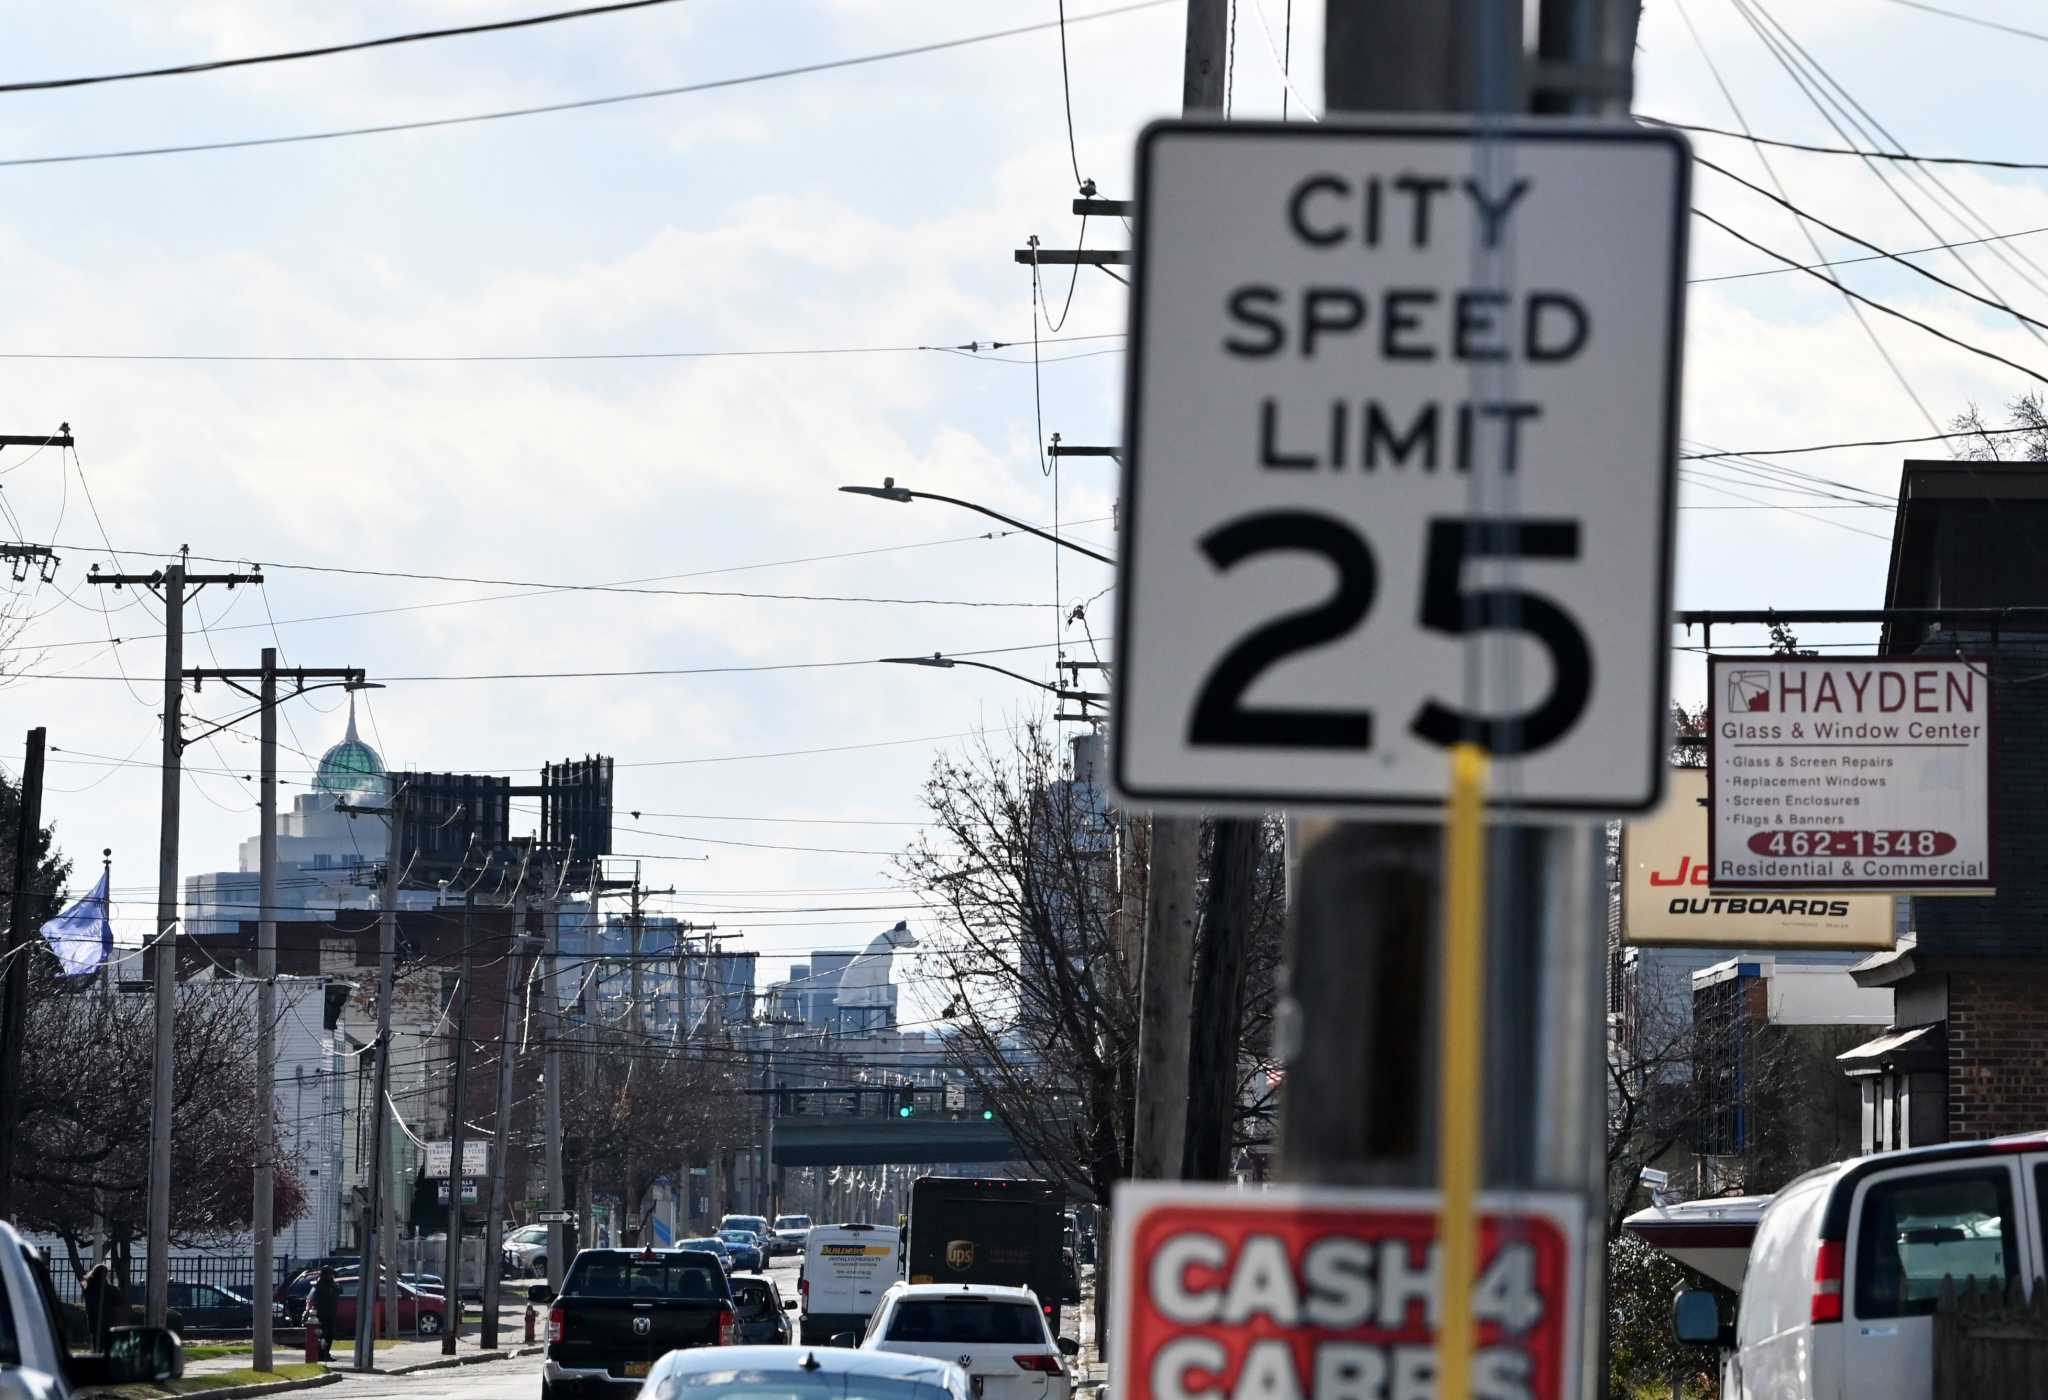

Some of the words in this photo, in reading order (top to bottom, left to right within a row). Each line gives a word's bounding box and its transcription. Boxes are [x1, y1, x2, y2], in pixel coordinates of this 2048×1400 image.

[1288, 173, 1533, 251] CITY
[1223, 284, 1590, 364] SPEED
[1260, 400, 1541, 473] LIMIT
[1187, 506, 1595, 758] 25
[1780, 670, 1973, 713] HAYDEN
[1721, 722, 1782, 739] Glass
[1791, 722, 1804, 739] &
[1814, 721, 1899, 739] Window
[1908, 721, 1980, 739] Center
[1733, 756, 1771, 768] Glass
[1776, 756, 1784, 767] &
[1790, 756, 1837, 767] Screen
[1842, 756, 1894, 770] Repairs
[1733, 776, 1821, 789] Replacement
[1826, 775, 1887, 787] Windows
[1733, 795, 1780, 806] Screen
[1785, 795, 1860, 806] Enclosures
[1733, 814, 1769, 827] Flags
[1775, 814, 1784, 825] &
[1789, 814, 1845, 825] Banners
[1768, 831, 1936, 856] 462-1548
[1721, 860, 1833, 877] Residential
[1842, 861, 1854, 877] &
[1863, 860, 1984, 877] Commercial
[1668, 898, 1849, 917] OUTBOARDS
[948, 1248, 973, 1267] ups
[1149, 1232, 1446, 1329] CASH
[1472, 1244, 1544, 1335] 4
